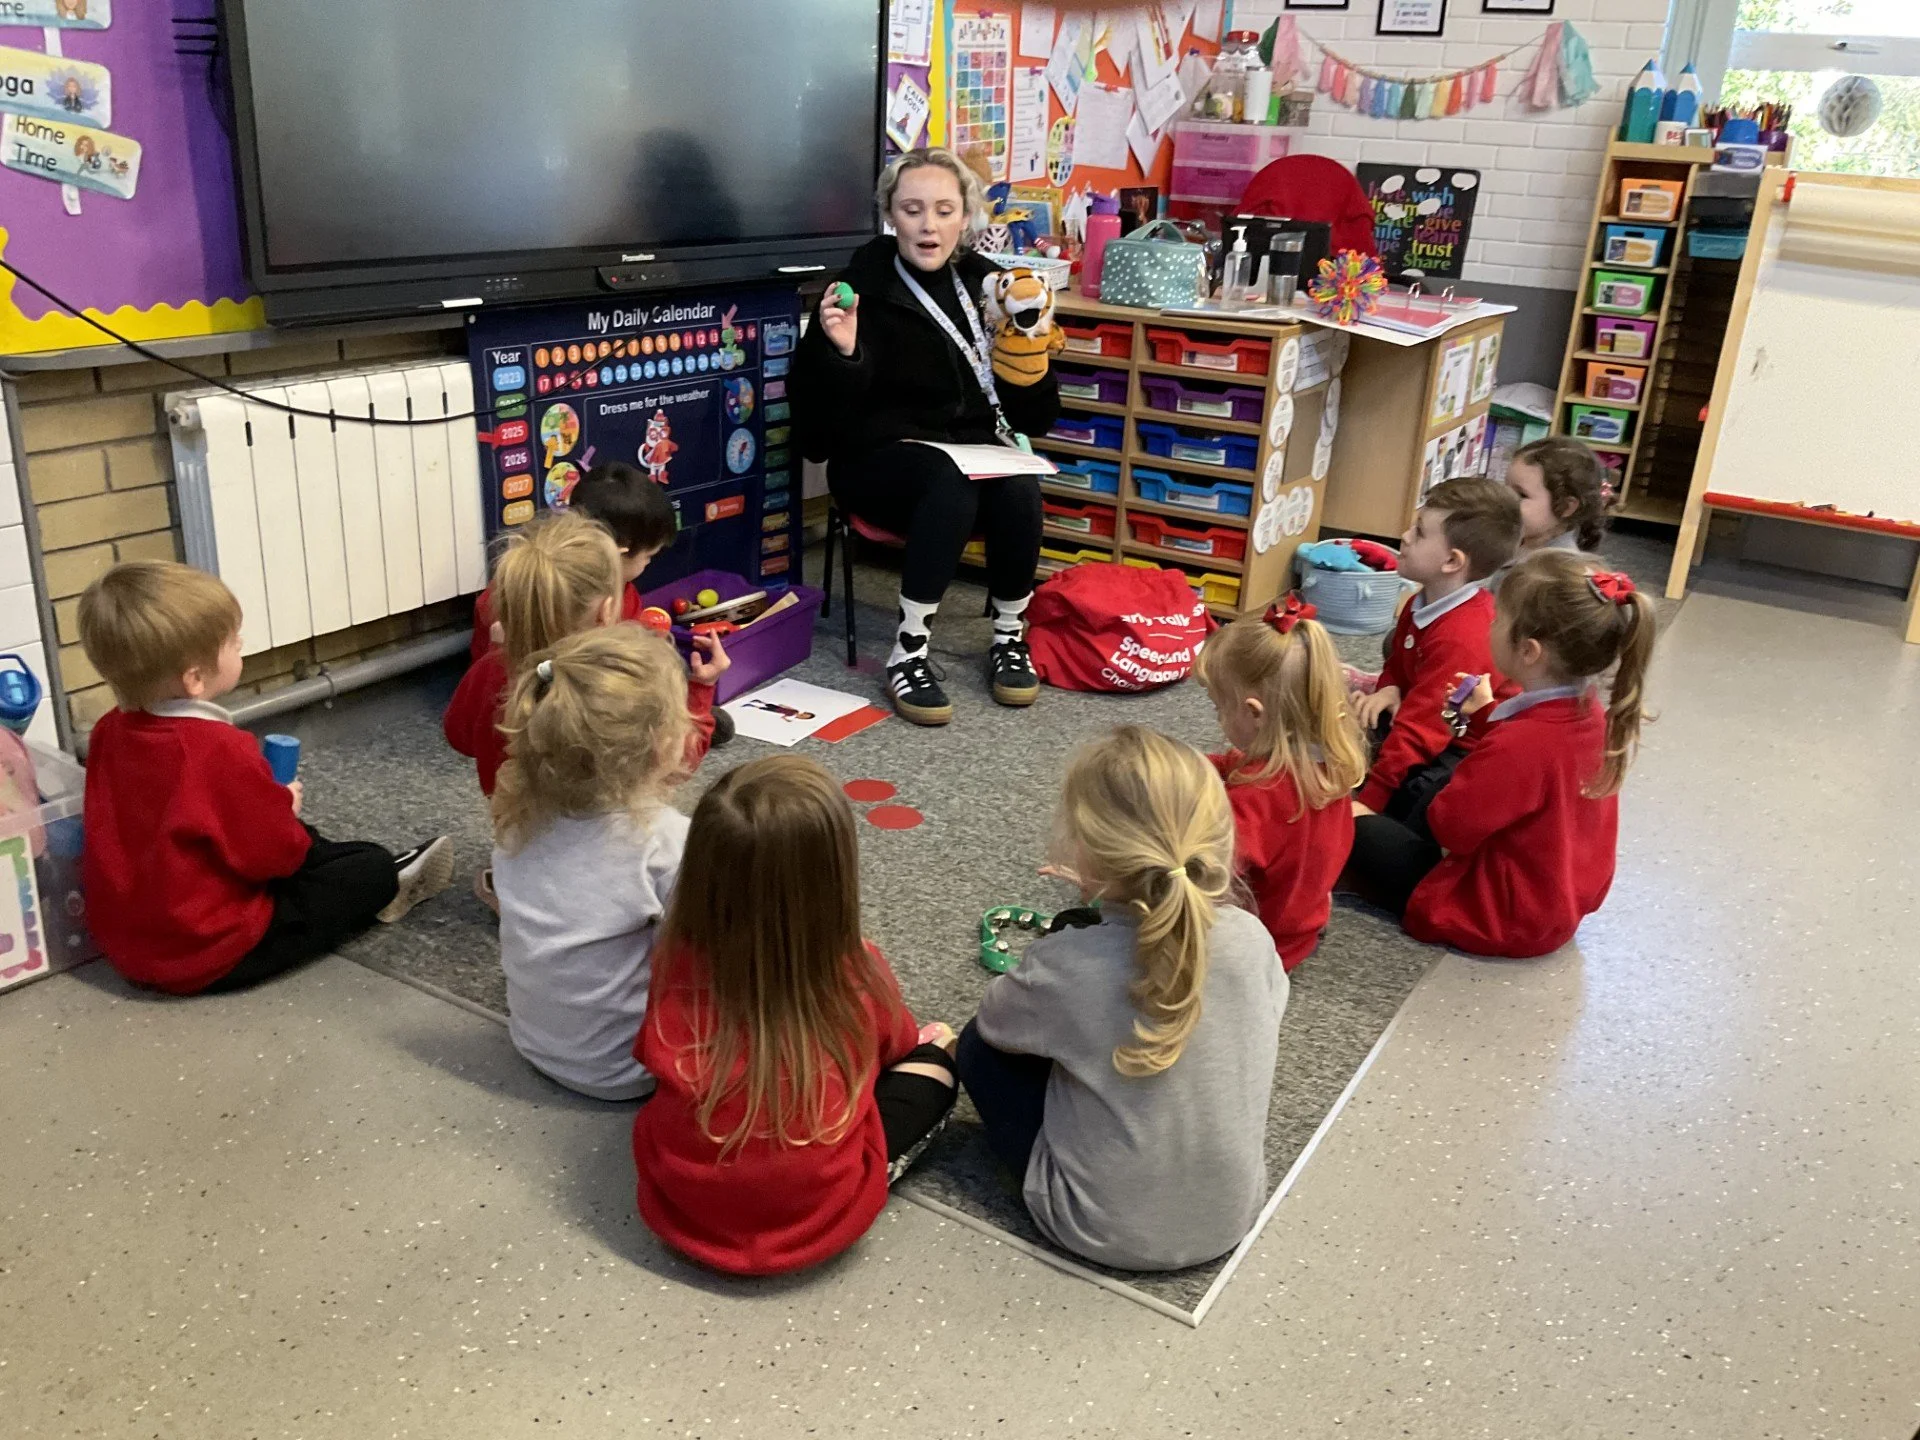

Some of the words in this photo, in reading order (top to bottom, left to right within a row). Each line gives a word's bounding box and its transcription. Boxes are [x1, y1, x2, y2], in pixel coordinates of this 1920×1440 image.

[0, 2, 25, 18] me
[0, 76, 34, 98] ga
[906, 85, 925, 107] CALM
[903, 94, 921, 114] BODY
[16, 116, 65, 145] Home
[15, 143, 57, 171] Time
[1412, 240, 1453, 258] trust
[588, 312, 609, 334] My
[613, 307, 649, 328] Daily
[652, 303, 716, 324] Calendar
[697, 333, 706, 345] 12
[492, 350, 521, 365] Year
[498, 371, 521, 386] 2023
[600, 403, 628, 416] Dress
[629, 400, 643, 411] me
[645, 396, 658, 408] for
[659, 394, 674, 407] the
[676, 389, 710, 403] weather
[502, 425, 524, 439] 2025
[504, 452, 527, 467] 2026
